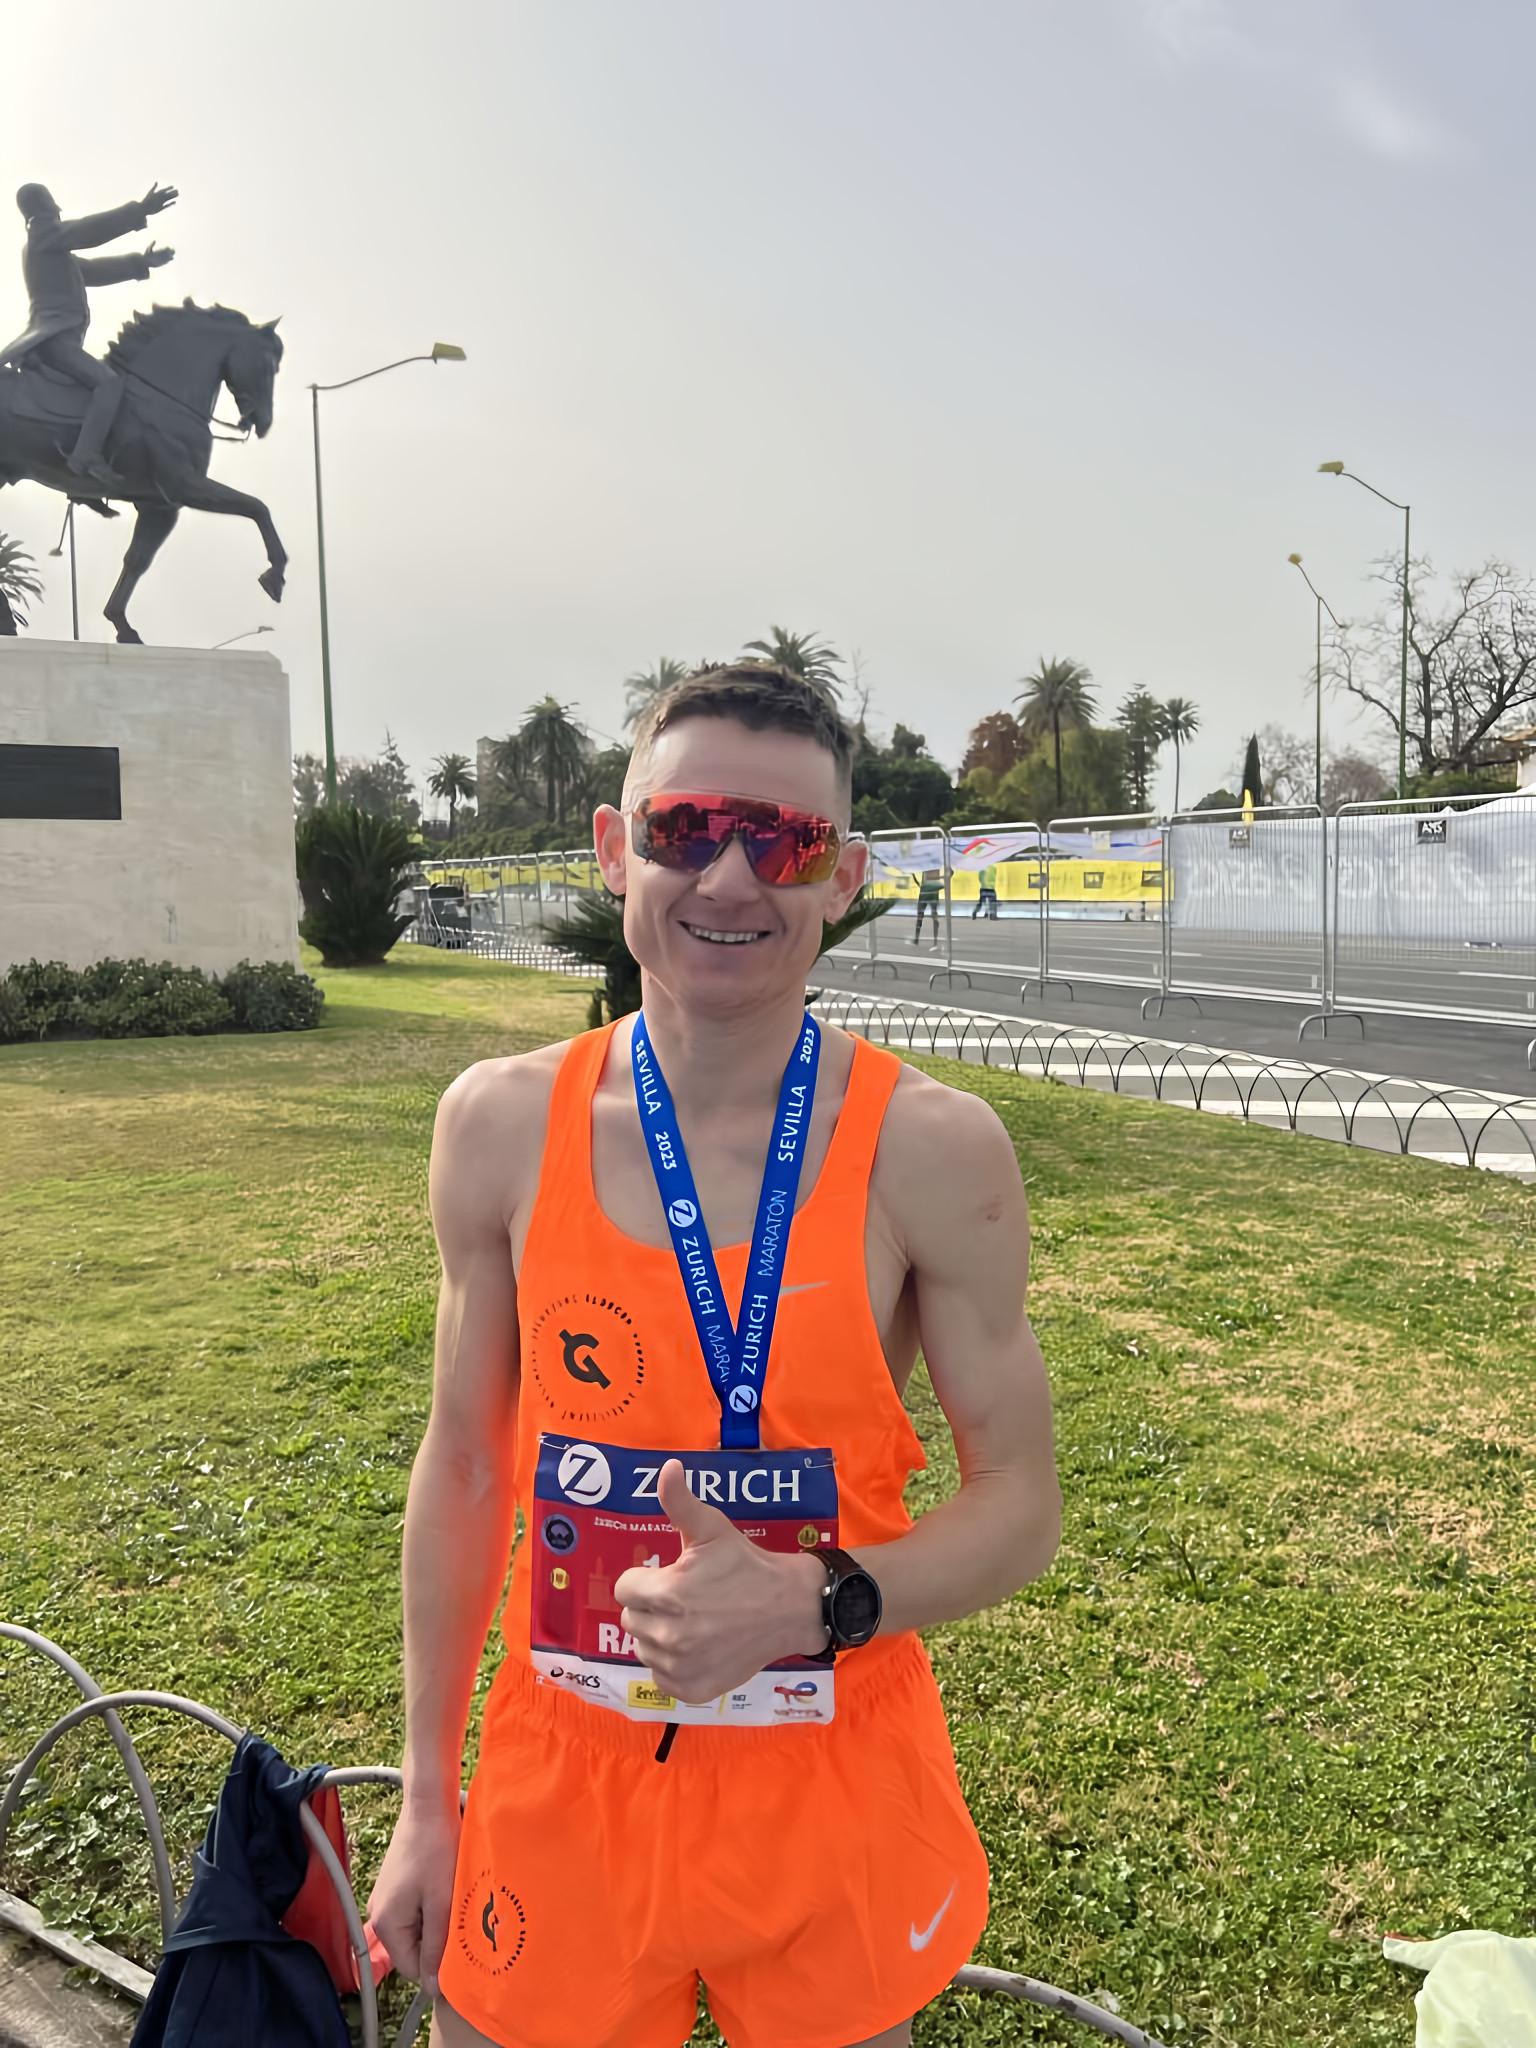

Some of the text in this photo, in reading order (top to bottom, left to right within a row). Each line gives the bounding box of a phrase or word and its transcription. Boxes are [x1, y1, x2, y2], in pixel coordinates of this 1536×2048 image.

[635, 1039, 662, 1115] SEVILLA
[655, 1131, 677, 1170] 2023
[682, 1236, 717, 1316] ZURICH
[706, 1324, 730, 1383] MARA
[740, 1294, 769, 1376] ZURICH
[757, 1190, 788, 1277] MARATÓN
[778, 1085, 807, 1162] SEVILLA
